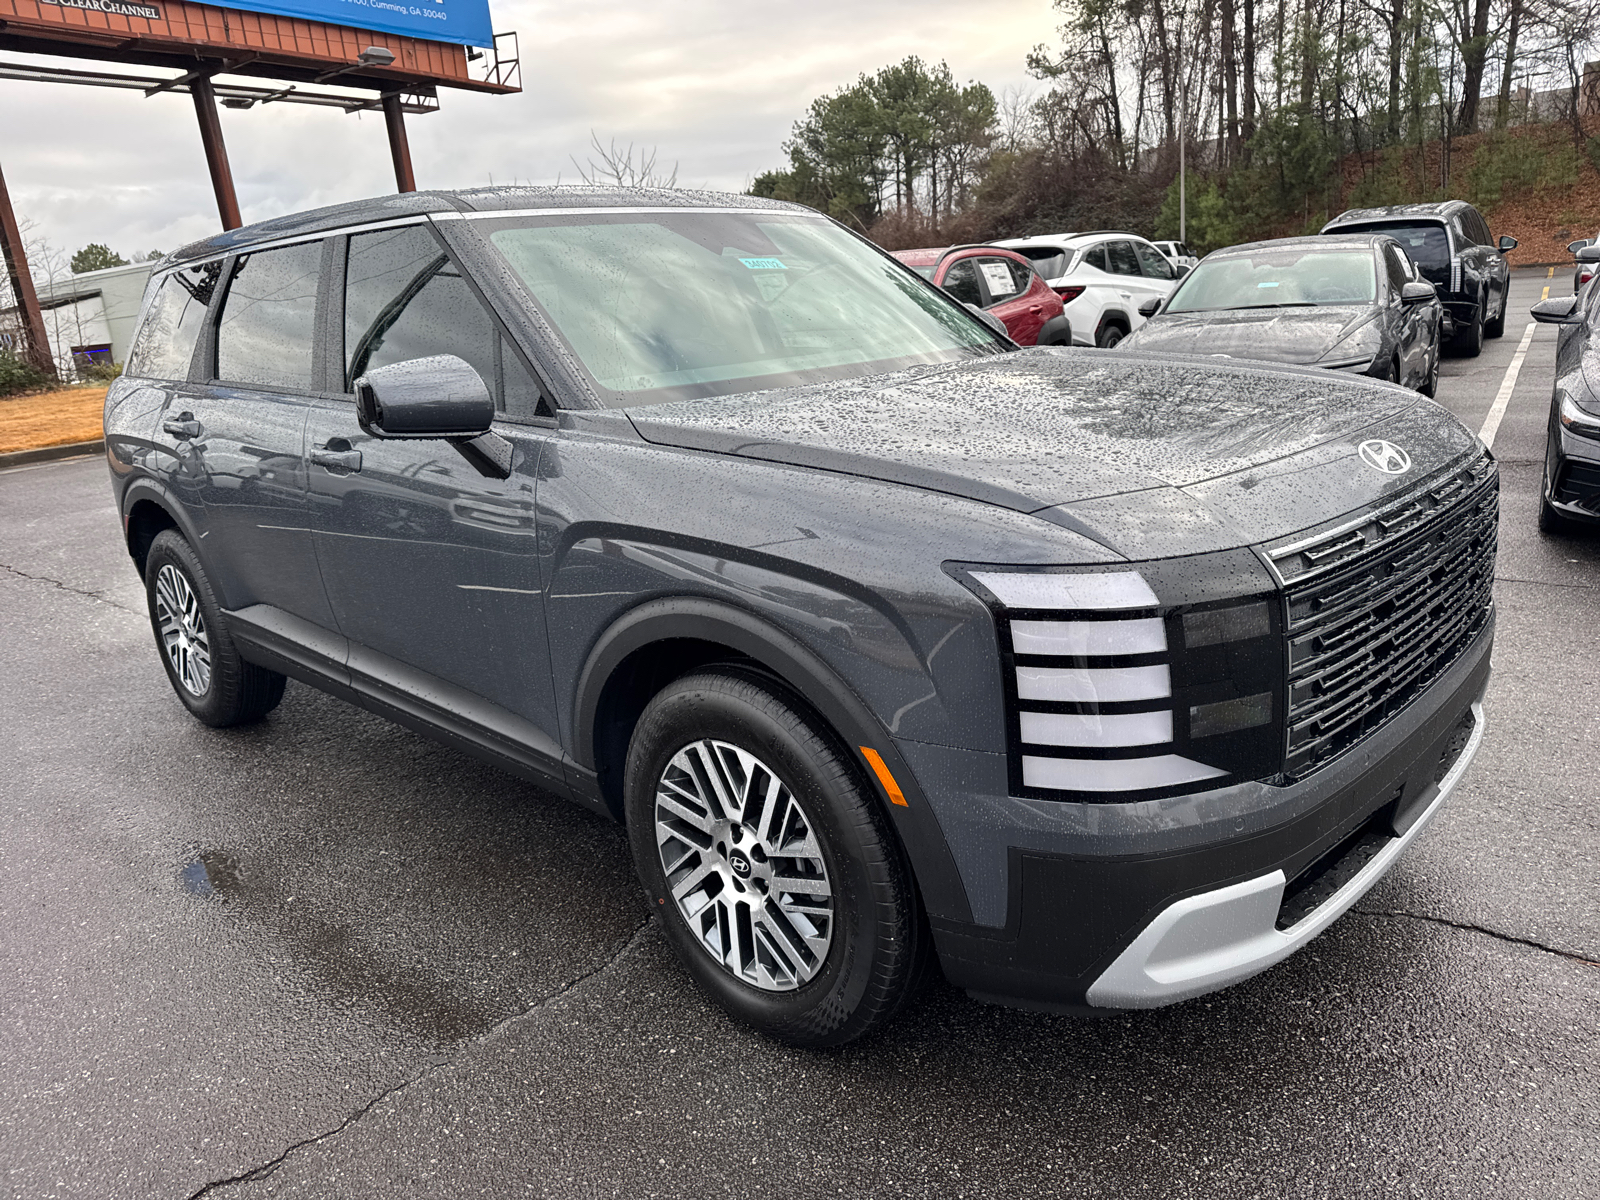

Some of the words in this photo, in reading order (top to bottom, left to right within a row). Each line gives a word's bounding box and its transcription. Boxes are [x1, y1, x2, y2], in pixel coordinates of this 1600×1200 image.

[371, 0, 408, 14] Cumming,
[410, 6, 421, 15] GA
[423, 9, 447, 20] 30040
